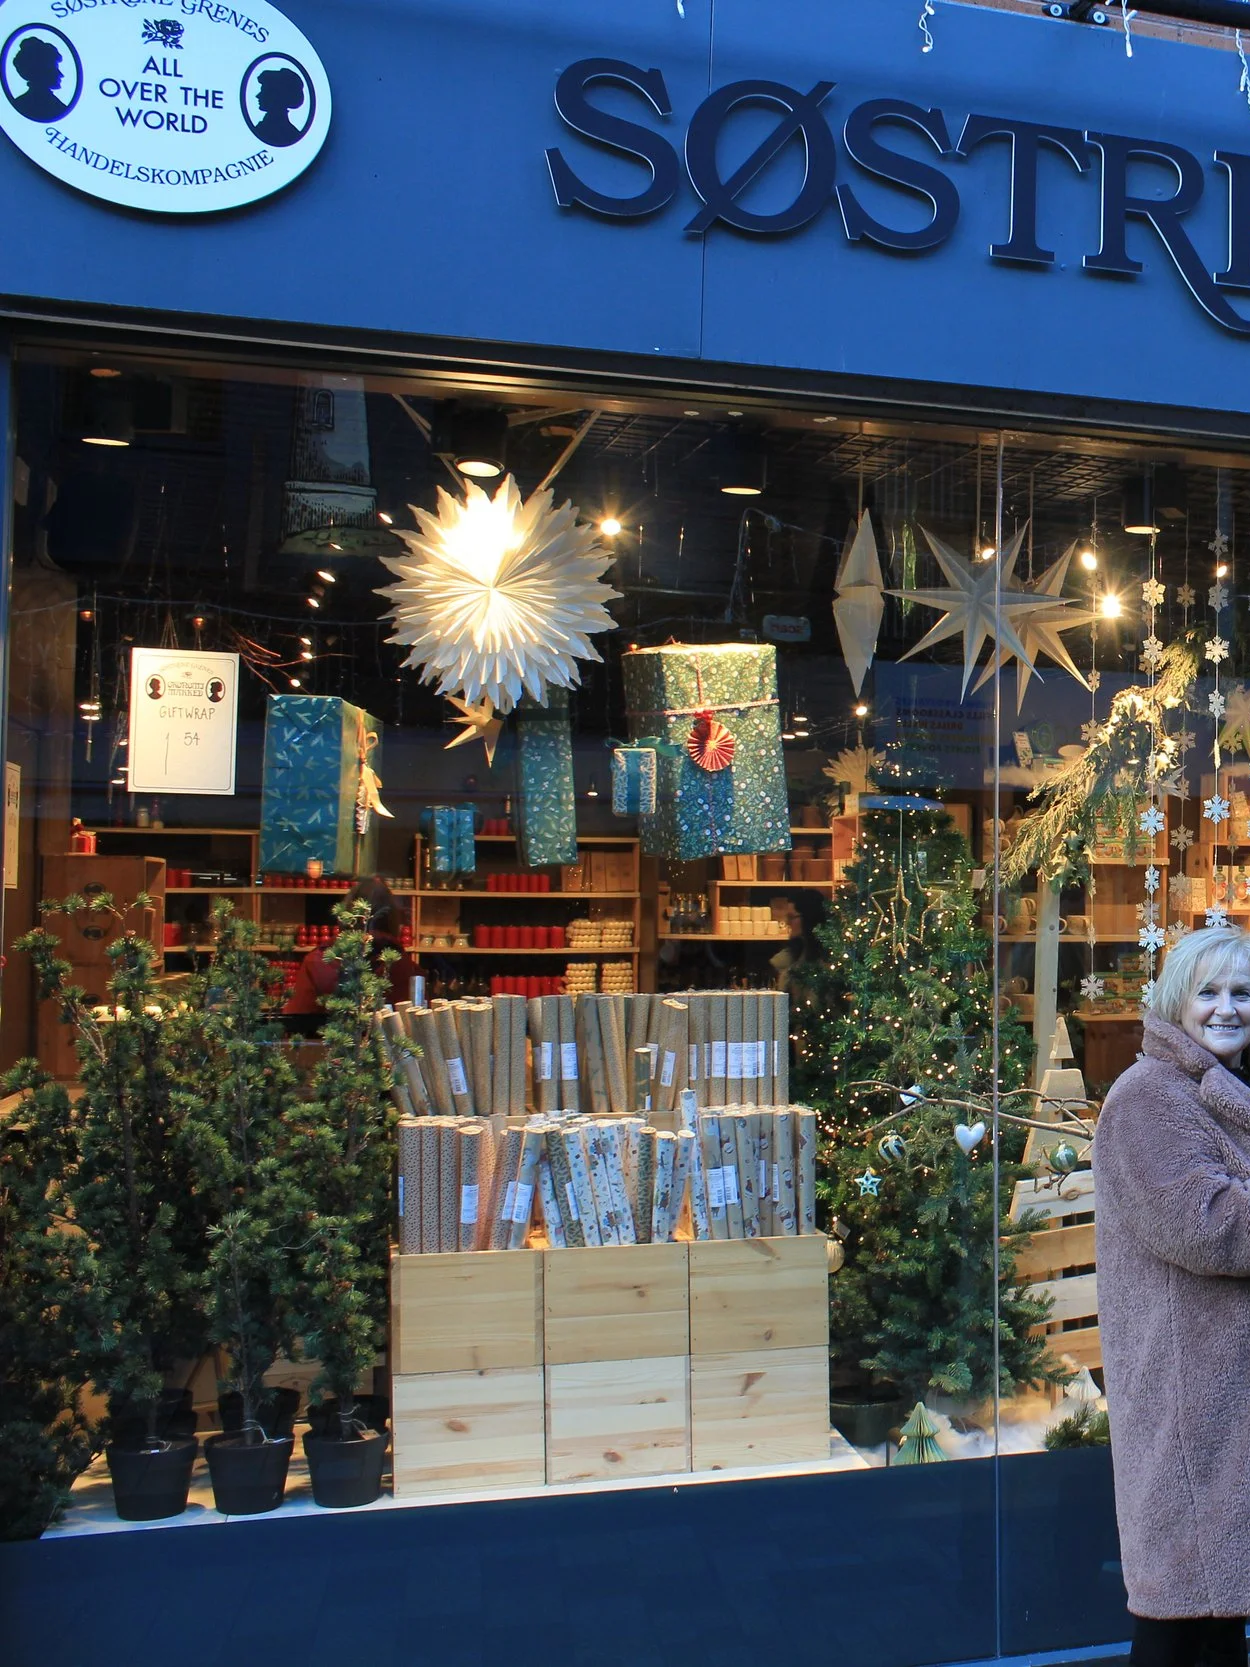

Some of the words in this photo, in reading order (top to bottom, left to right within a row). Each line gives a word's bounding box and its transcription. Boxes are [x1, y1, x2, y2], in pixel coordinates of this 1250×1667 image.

[142, 55, 183, 78] ALL
[99, 78, 167, 103] OVER
[180, 86, 224, 109] THE
[115, 106, 208, 134] WORLD
[45, 127, 275, 186] HANDELSKOMPAGNIE
[159, 704, 216, 720] GIFTWRAP
[183, 731, 201, 747] 54
